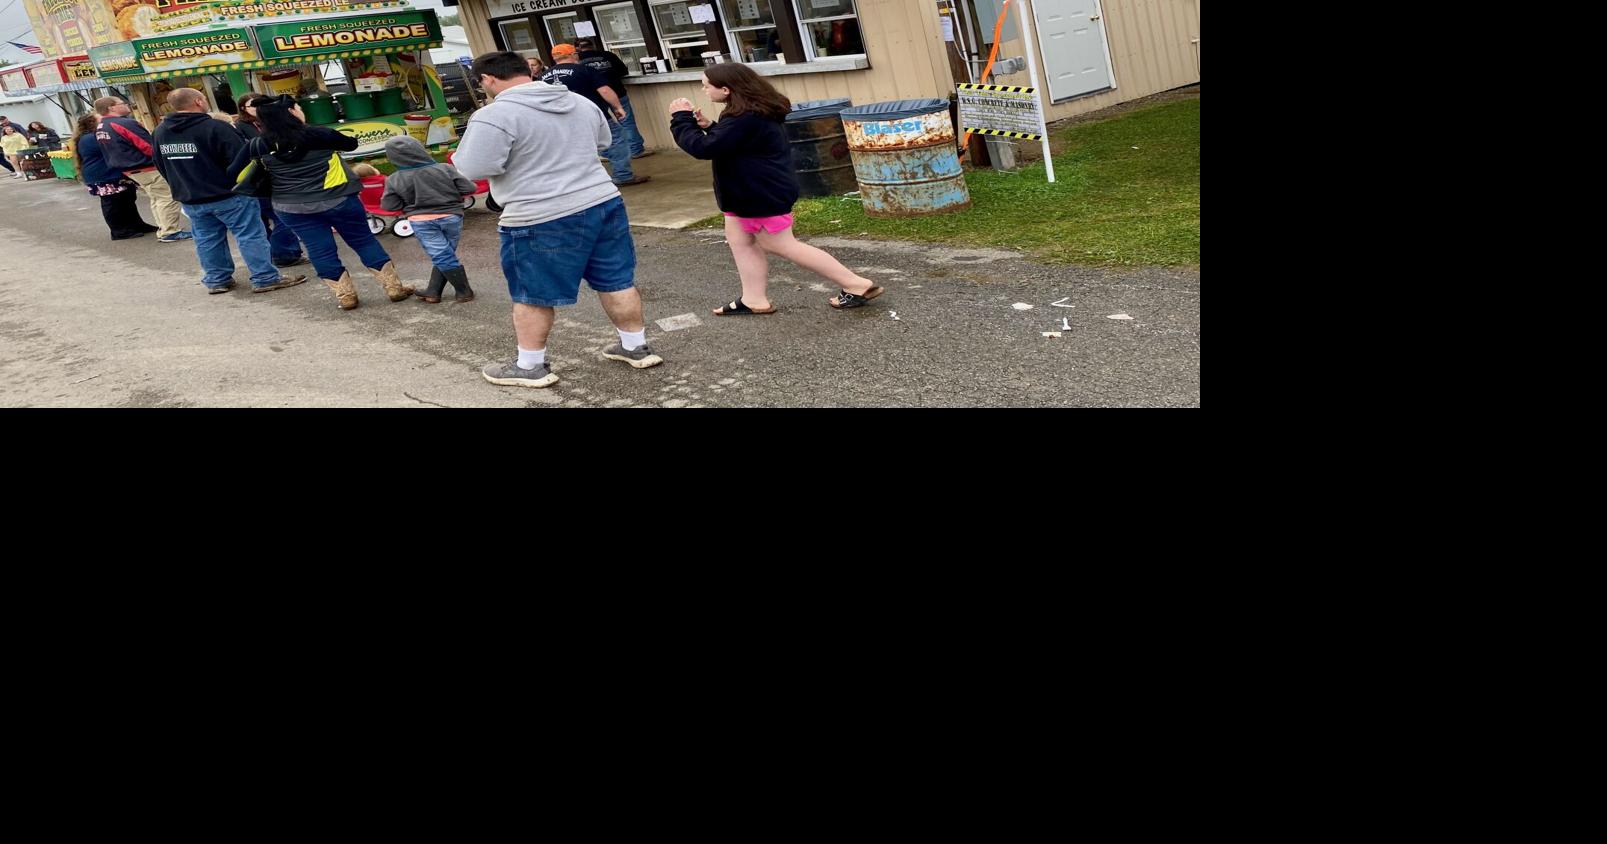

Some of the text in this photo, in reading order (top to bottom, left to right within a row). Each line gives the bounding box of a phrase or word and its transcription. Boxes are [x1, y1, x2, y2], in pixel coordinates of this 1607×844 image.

[221, 5, 263, 15] FRESH
[265, 0, 332, 11] SQUEEZED
[512, 0, 567, 13] ICE CREAM
[300, 18, 396, 32] FRESH SQUEEZED
[142, 33, 240, 49] FRESH SQUEEZED
[275, 24, 428, 51] LEMONADE
[142, 41, 248, 61] LEMONADE
[98, 57, 139, 71] LEMONADE
[864, 121, 922, 135] Blaser
